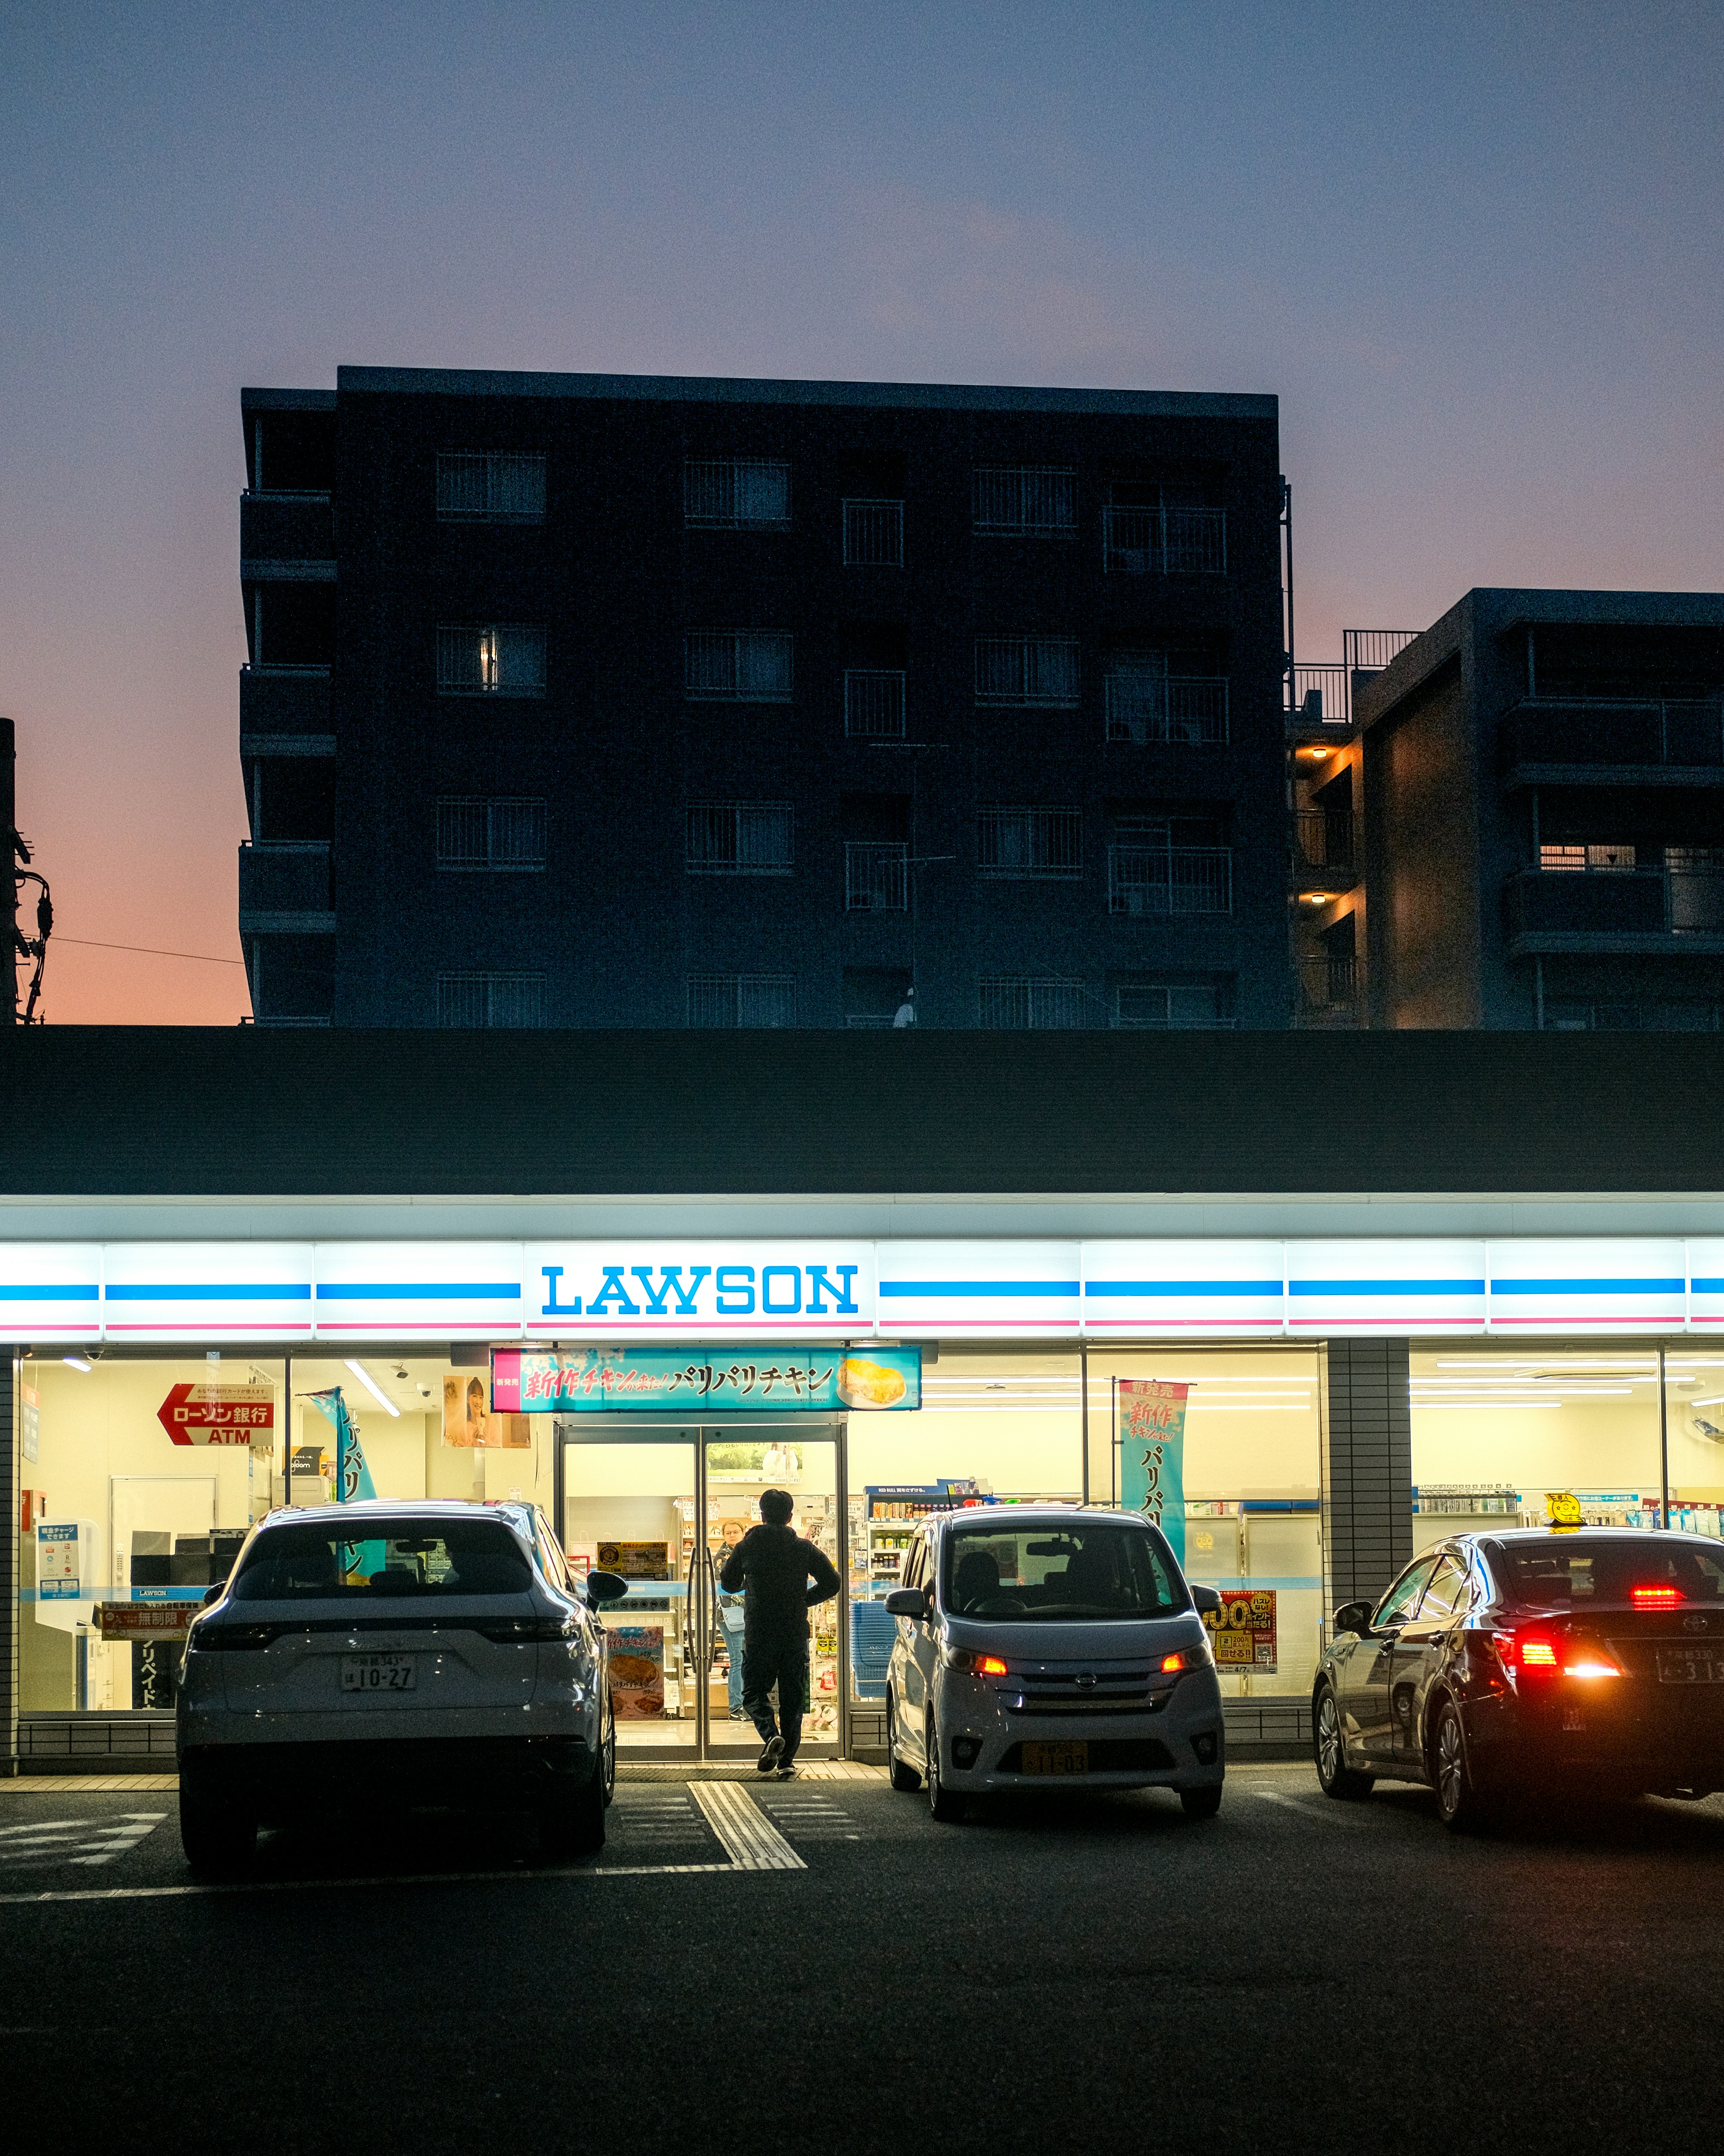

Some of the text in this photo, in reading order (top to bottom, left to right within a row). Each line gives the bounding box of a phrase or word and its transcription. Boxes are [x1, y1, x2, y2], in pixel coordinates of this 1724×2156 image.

[542, 1266, 858, 1314] LAWSON
[668, 1365, 833, 1395] パリパリチキン
[1132, 1382, 1174, 1398] 新発売
[174, 1407, 268, 1423] ローソン銀行
[1129, 1401, 1173, 1427] 新作
[208, 1429, 250, 1444] ATM
[41, 1526, 75, 1534] 現金チャージ
[139, 1612, 177, 1625] 無制限
[1247, 1620, 1271, 1628] 当たる!
[141, 1641, 157, 1710] リペイド
[360, 1668, 411, 1687] 10-27
